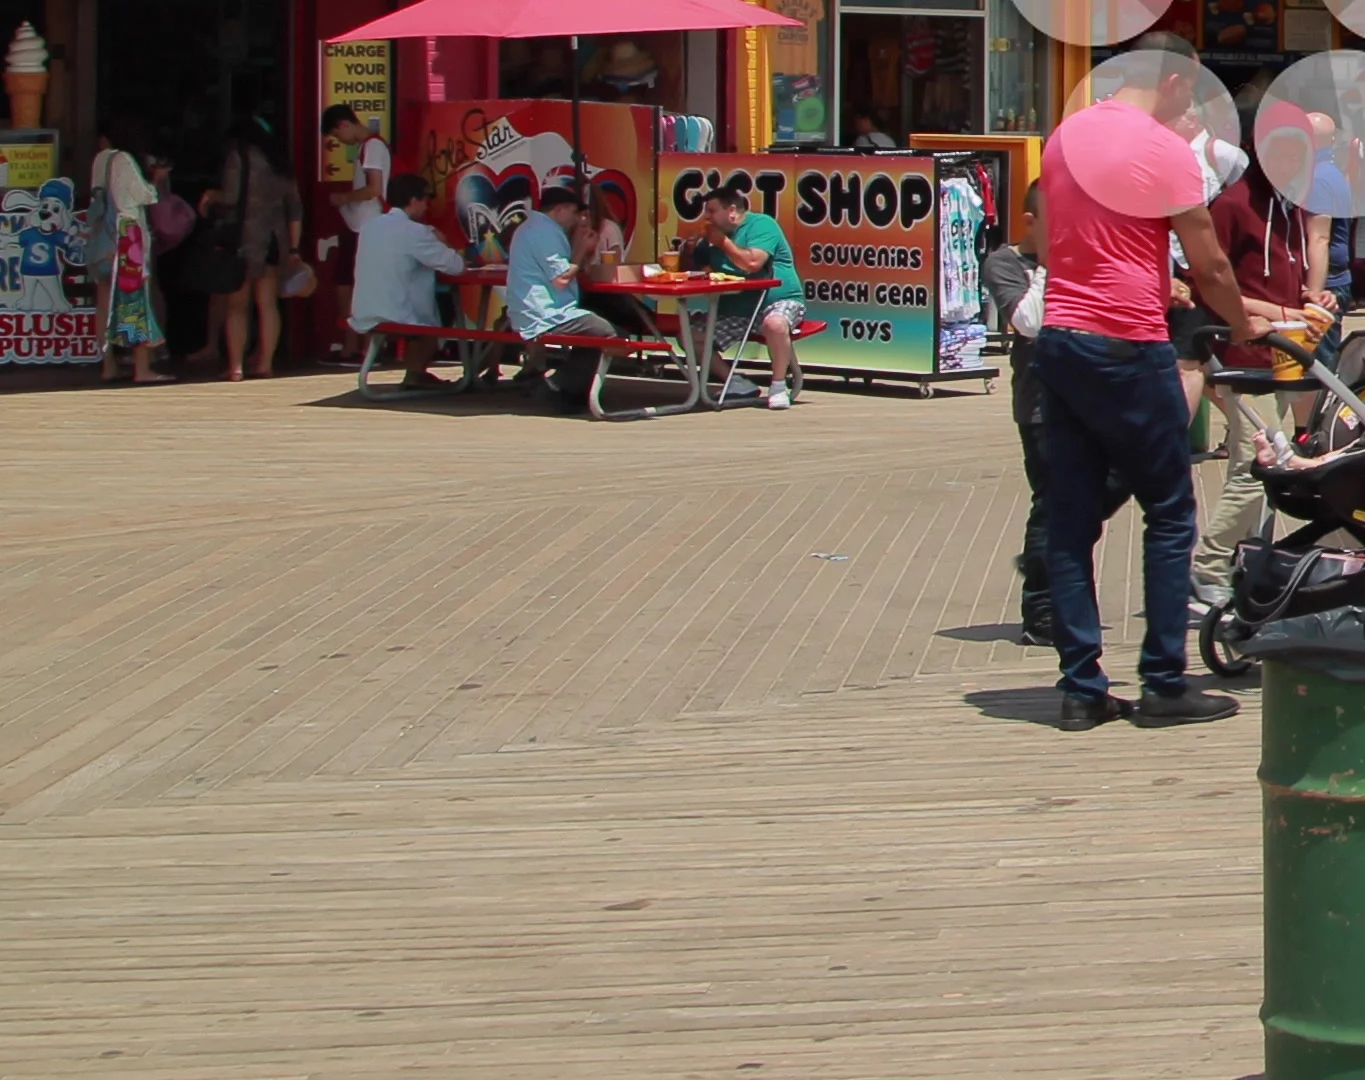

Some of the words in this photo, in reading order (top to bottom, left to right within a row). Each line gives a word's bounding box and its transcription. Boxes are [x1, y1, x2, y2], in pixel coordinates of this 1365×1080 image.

[325, 45, 385, 58] CHARGE
[345, 63, 385, 75] YOUR
[334, 81, 385, 94] PHONE
[797, 171, 933, 230] SHOP
[839, 320, 893, 342] TOYS
